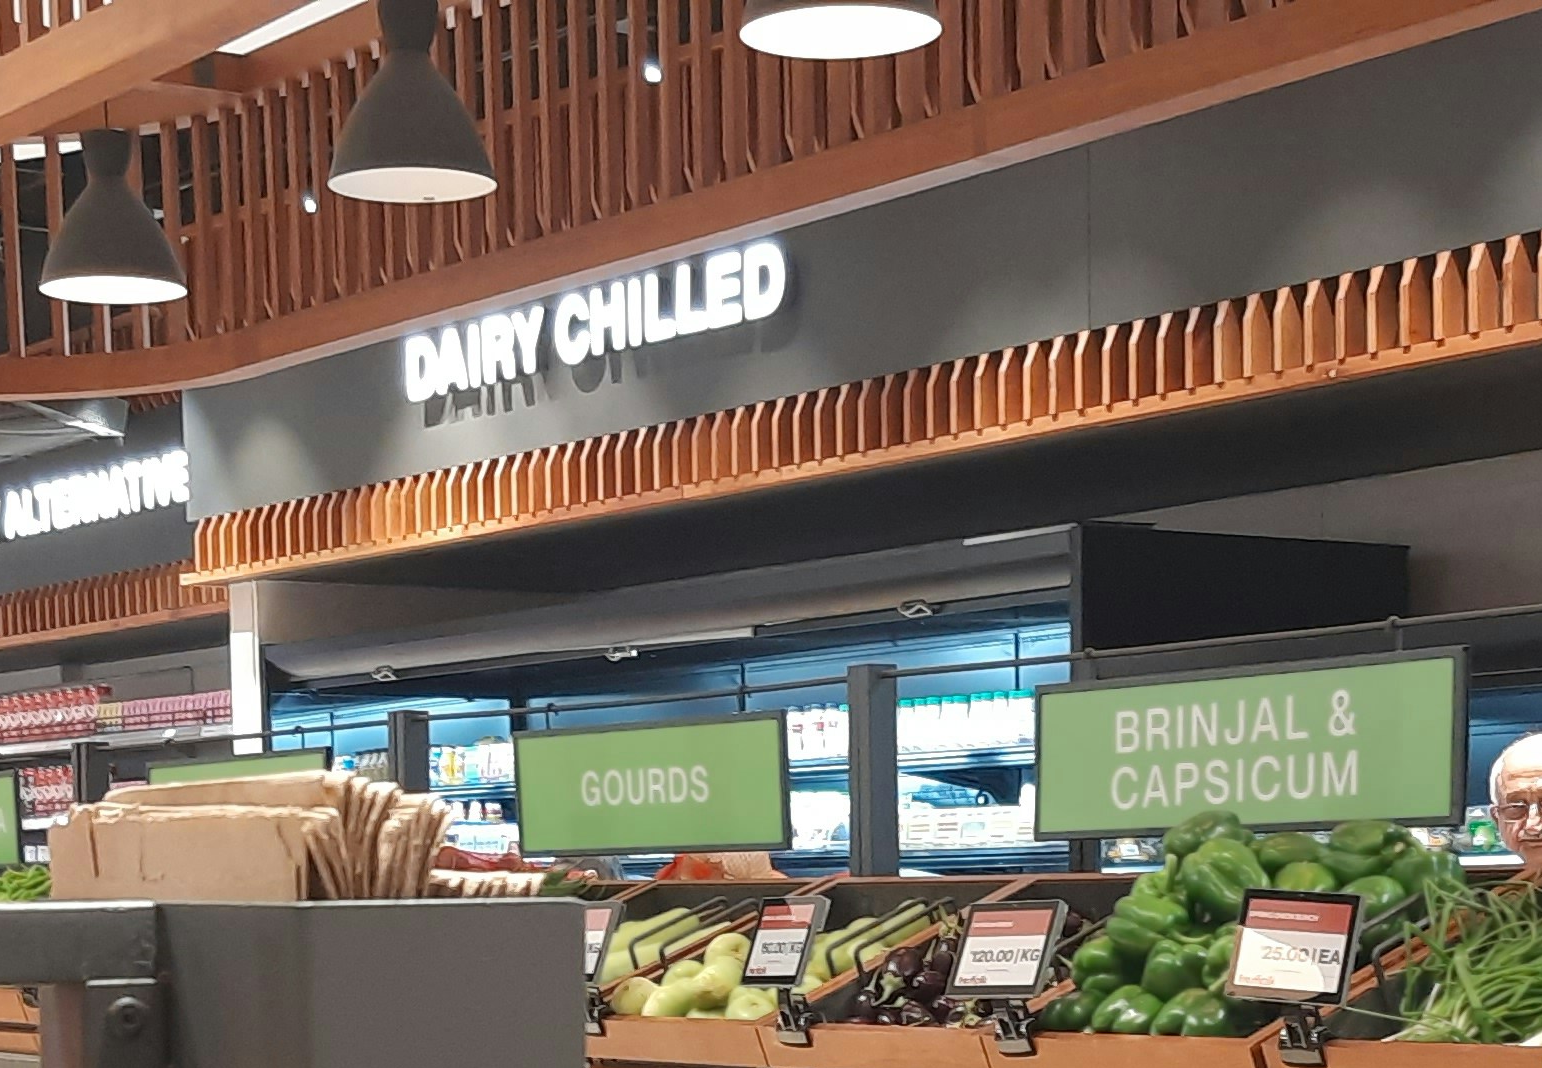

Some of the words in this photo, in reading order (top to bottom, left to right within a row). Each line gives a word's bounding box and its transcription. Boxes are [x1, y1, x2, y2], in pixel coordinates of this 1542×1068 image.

[404, 305, 546, 403] DAIRY
[554, 241, 787, 366] CHILLED
[1115, 695, 1309, 754] BRINJAL
[1328, 689, 1357, 737] &
[581, 765, 709, 806] GOURDS
[1111, 749, 1359, 811] CAPSICUM
